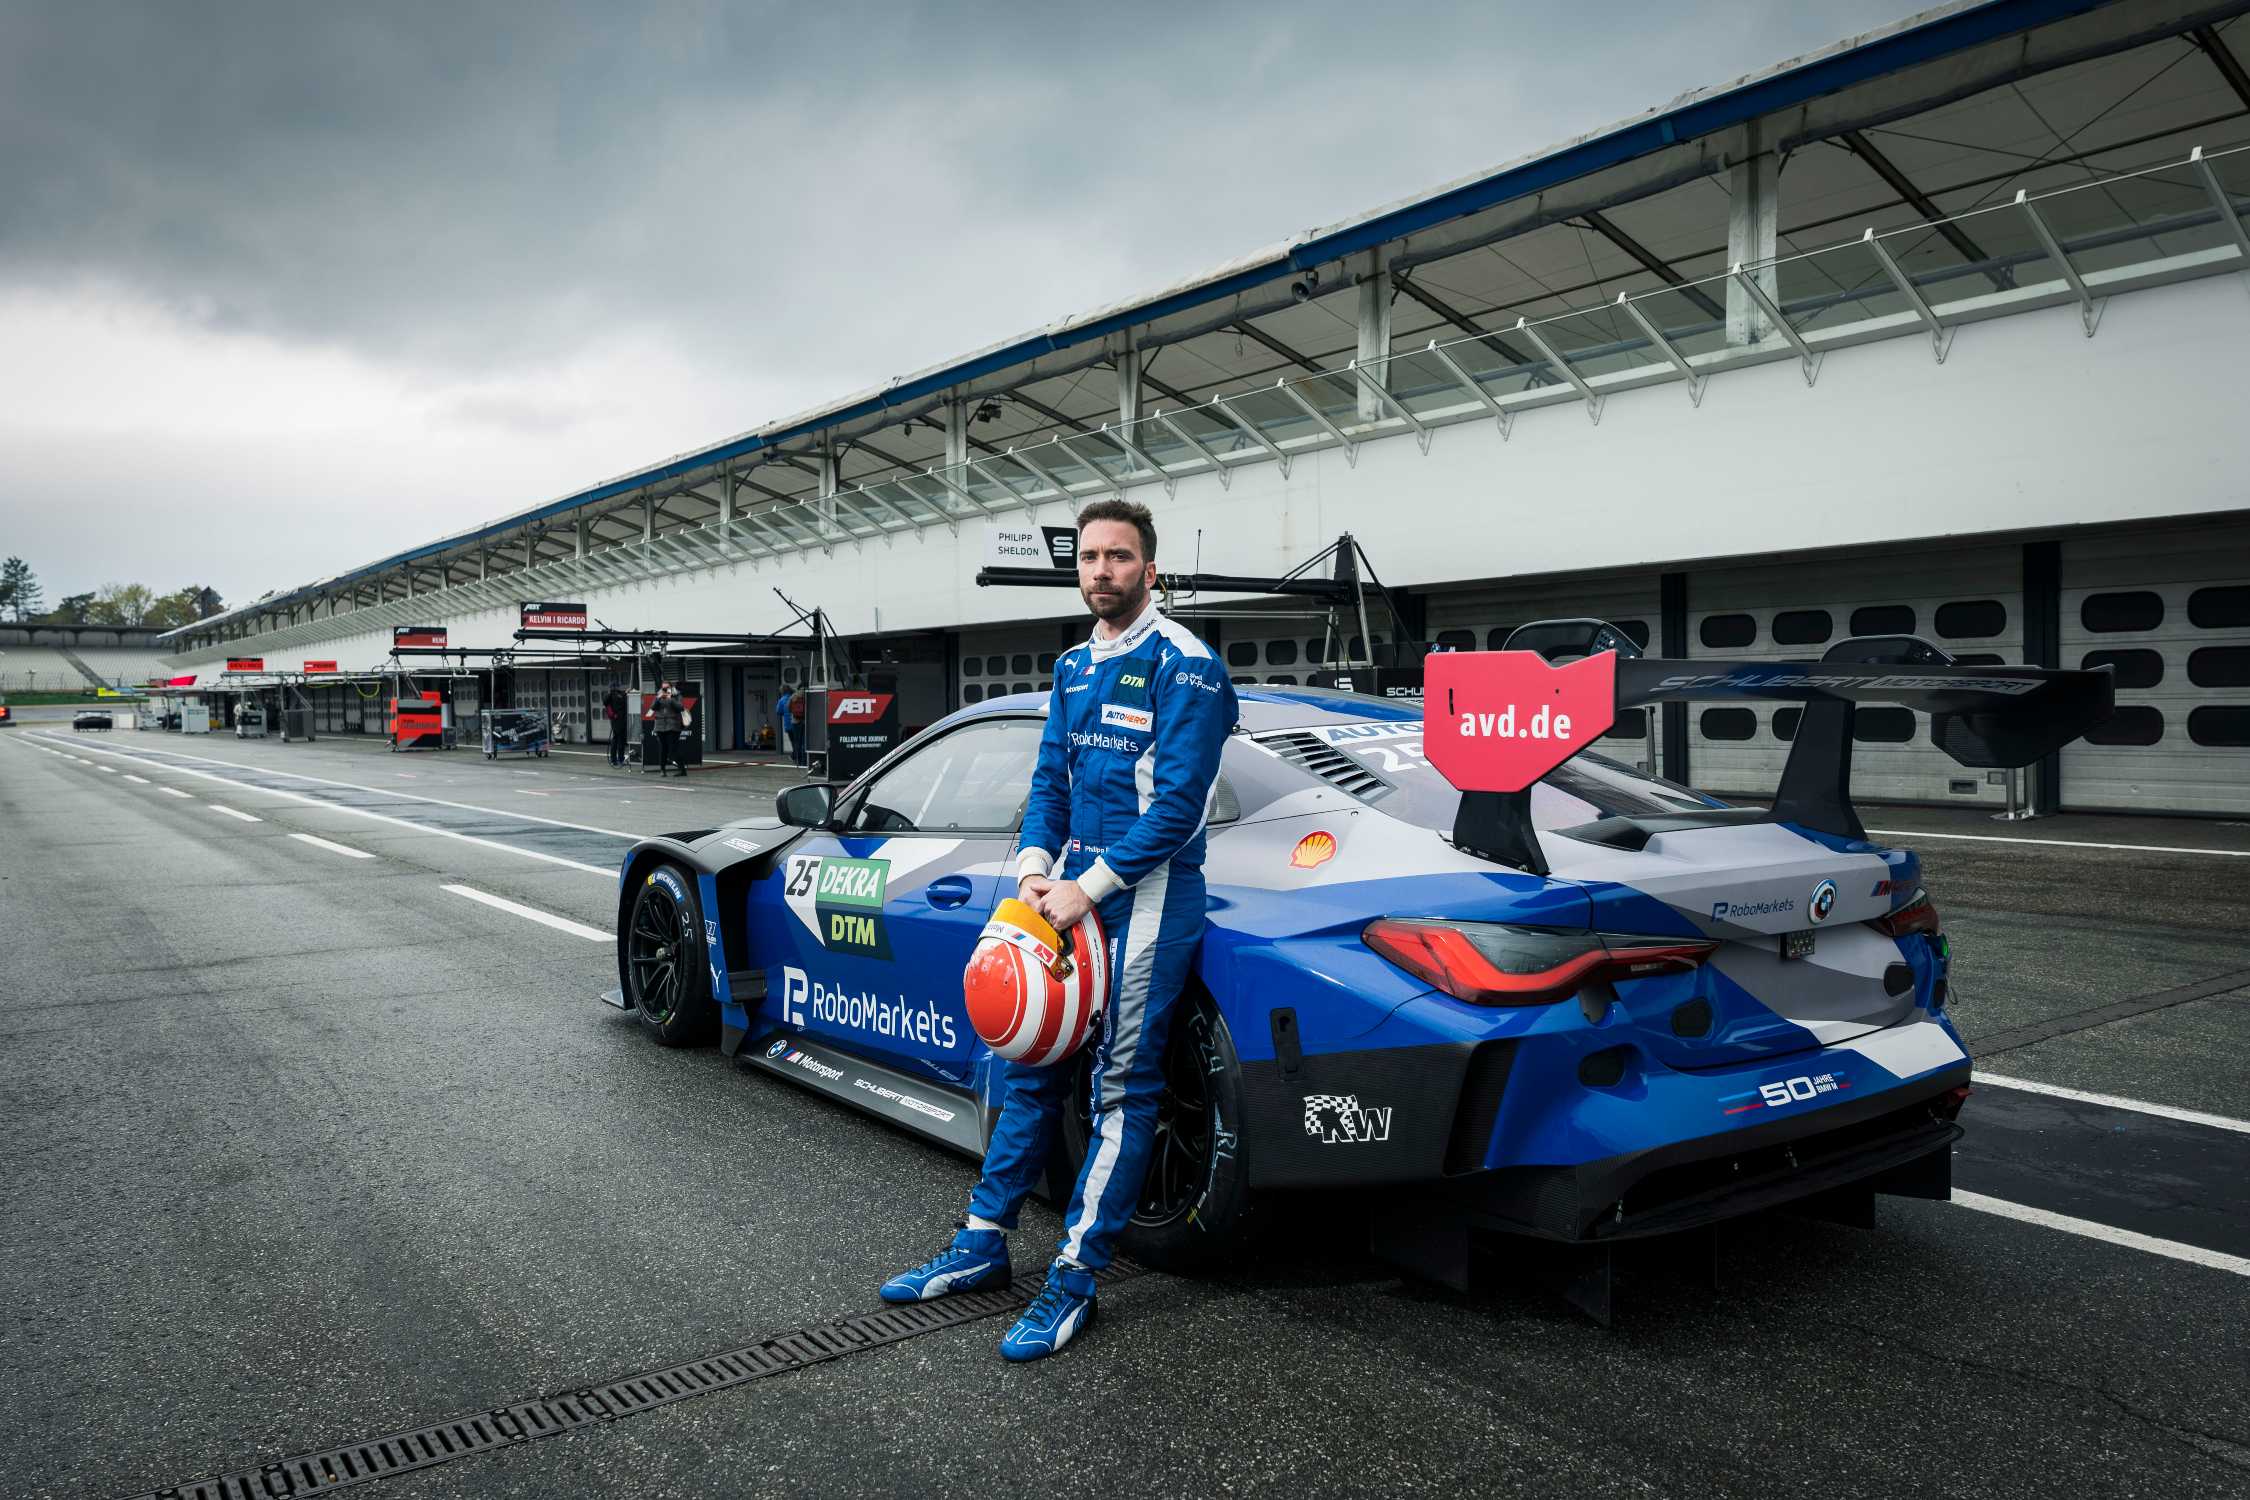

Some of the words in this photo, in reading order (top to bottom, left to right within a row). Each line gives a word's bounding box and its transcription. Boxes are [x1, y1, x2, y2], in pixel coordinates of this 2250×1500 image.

[998, 532, 1033, 542] PHILIPP
[998, 546, 1039, 556] SHELDON
[523, 603, 542, 612] ABT
[529, 615, 552, 624] KELVIN
[557, 615, 586, 625] RICARDO
[1120, 674, 1146, 688] DTM
[832, 698, 877, 719] ABT
[1105, 710, 1148, 726] AUTOHERO
[1459, 704, 1572, 740] avd.de
[840, 735, 858, 743] FOLLOW
[859, 735, 867, 743] THE
[868, 735, 888, 743] JOURNEY
[656, 872, 682, 901] MICHELIN
[785, 859, 821, 897] 25
[819, 865, 883, 898] DEKRA
[1729, 898, 1794, 918] RoboMarkets
[831, 914, 876, 947] DTM
[812, 981, 957, 1049] RoboMarkets
[798, 1055, 844, 1081] Motorsport
[1812, 1073, 1834, 1085] JAHRE
[1816, 1085, 1831, 1094] BMW
[1831, 1083, 1839, 1091] M
[853, 1078, 904, 1102] SCHUBERT
[1758, 1076, 1818, 1107] 50
